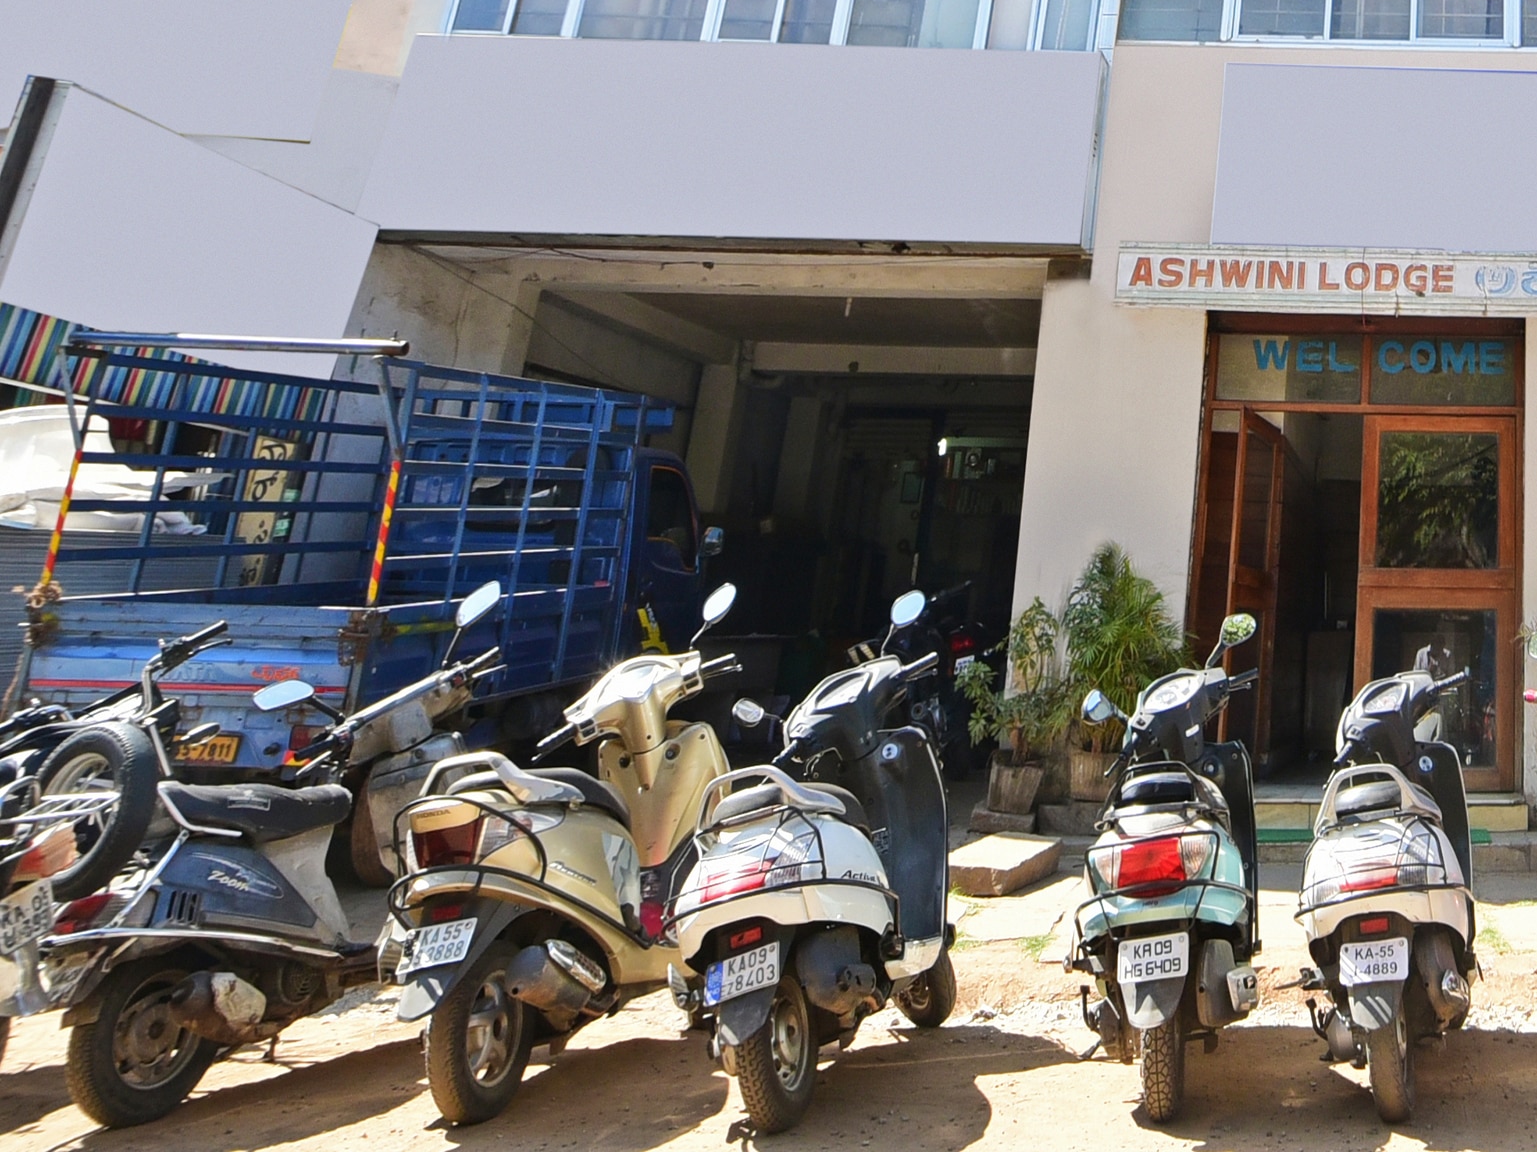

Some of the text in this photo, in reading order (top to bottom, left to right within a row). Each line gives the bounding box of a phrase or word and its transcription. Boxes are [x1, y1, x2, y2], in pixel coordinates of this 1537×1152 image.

[1129, 256, 1455, 293] ASHWINI LODGE
[162, 663, 217, 682] ATA
[415, 809, 451, 820] HONDA
[1355, 945, 1395, 960] KA-55
